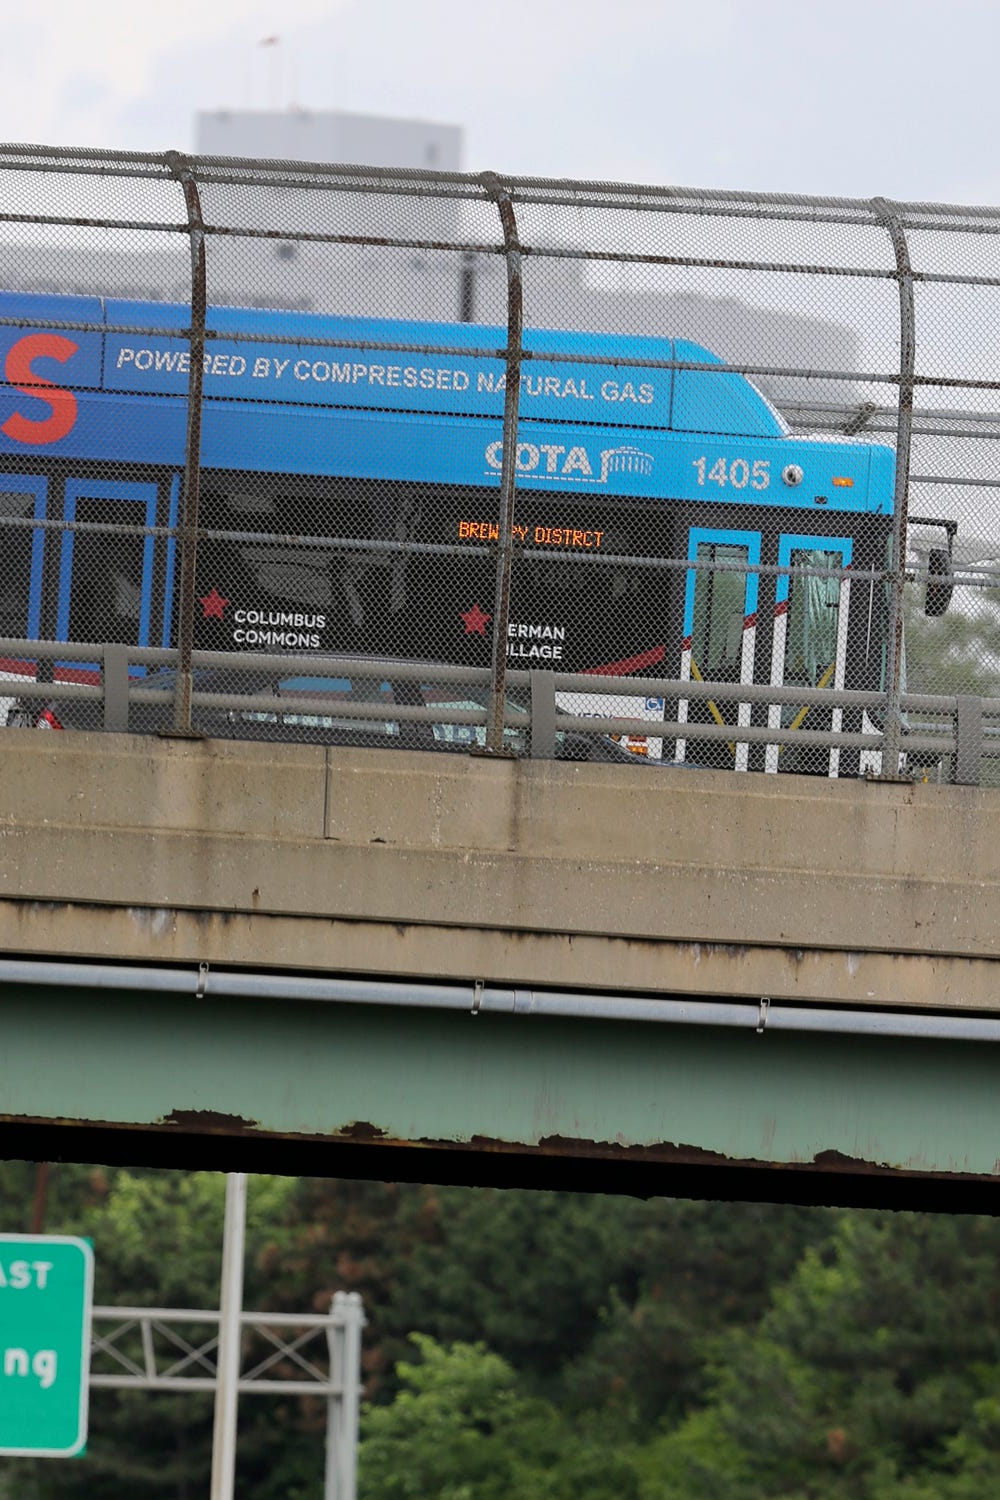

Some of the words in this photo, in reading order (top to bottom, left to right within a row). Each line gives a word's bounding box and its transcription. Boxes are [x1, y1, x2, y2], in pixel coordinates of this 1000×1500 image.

[252, 357, 289, 378] BY
[294, 360, 469, 391] COMPRESSED
[477, 372, 594, 400] NAURAL
[601, 380, 655, 404] GAS
[484, 440, 593, 476] COTA
[692, 456, 771, 489] 1405
[458, 521, 529, 541] BREWRY
[234, 610, 326, 628] COLUMBUS
[233, 629, 321, 648] COMMONS
[508, 623, 565, 640] ERMAN
[505, 643, 563, 660] ILLAGE
